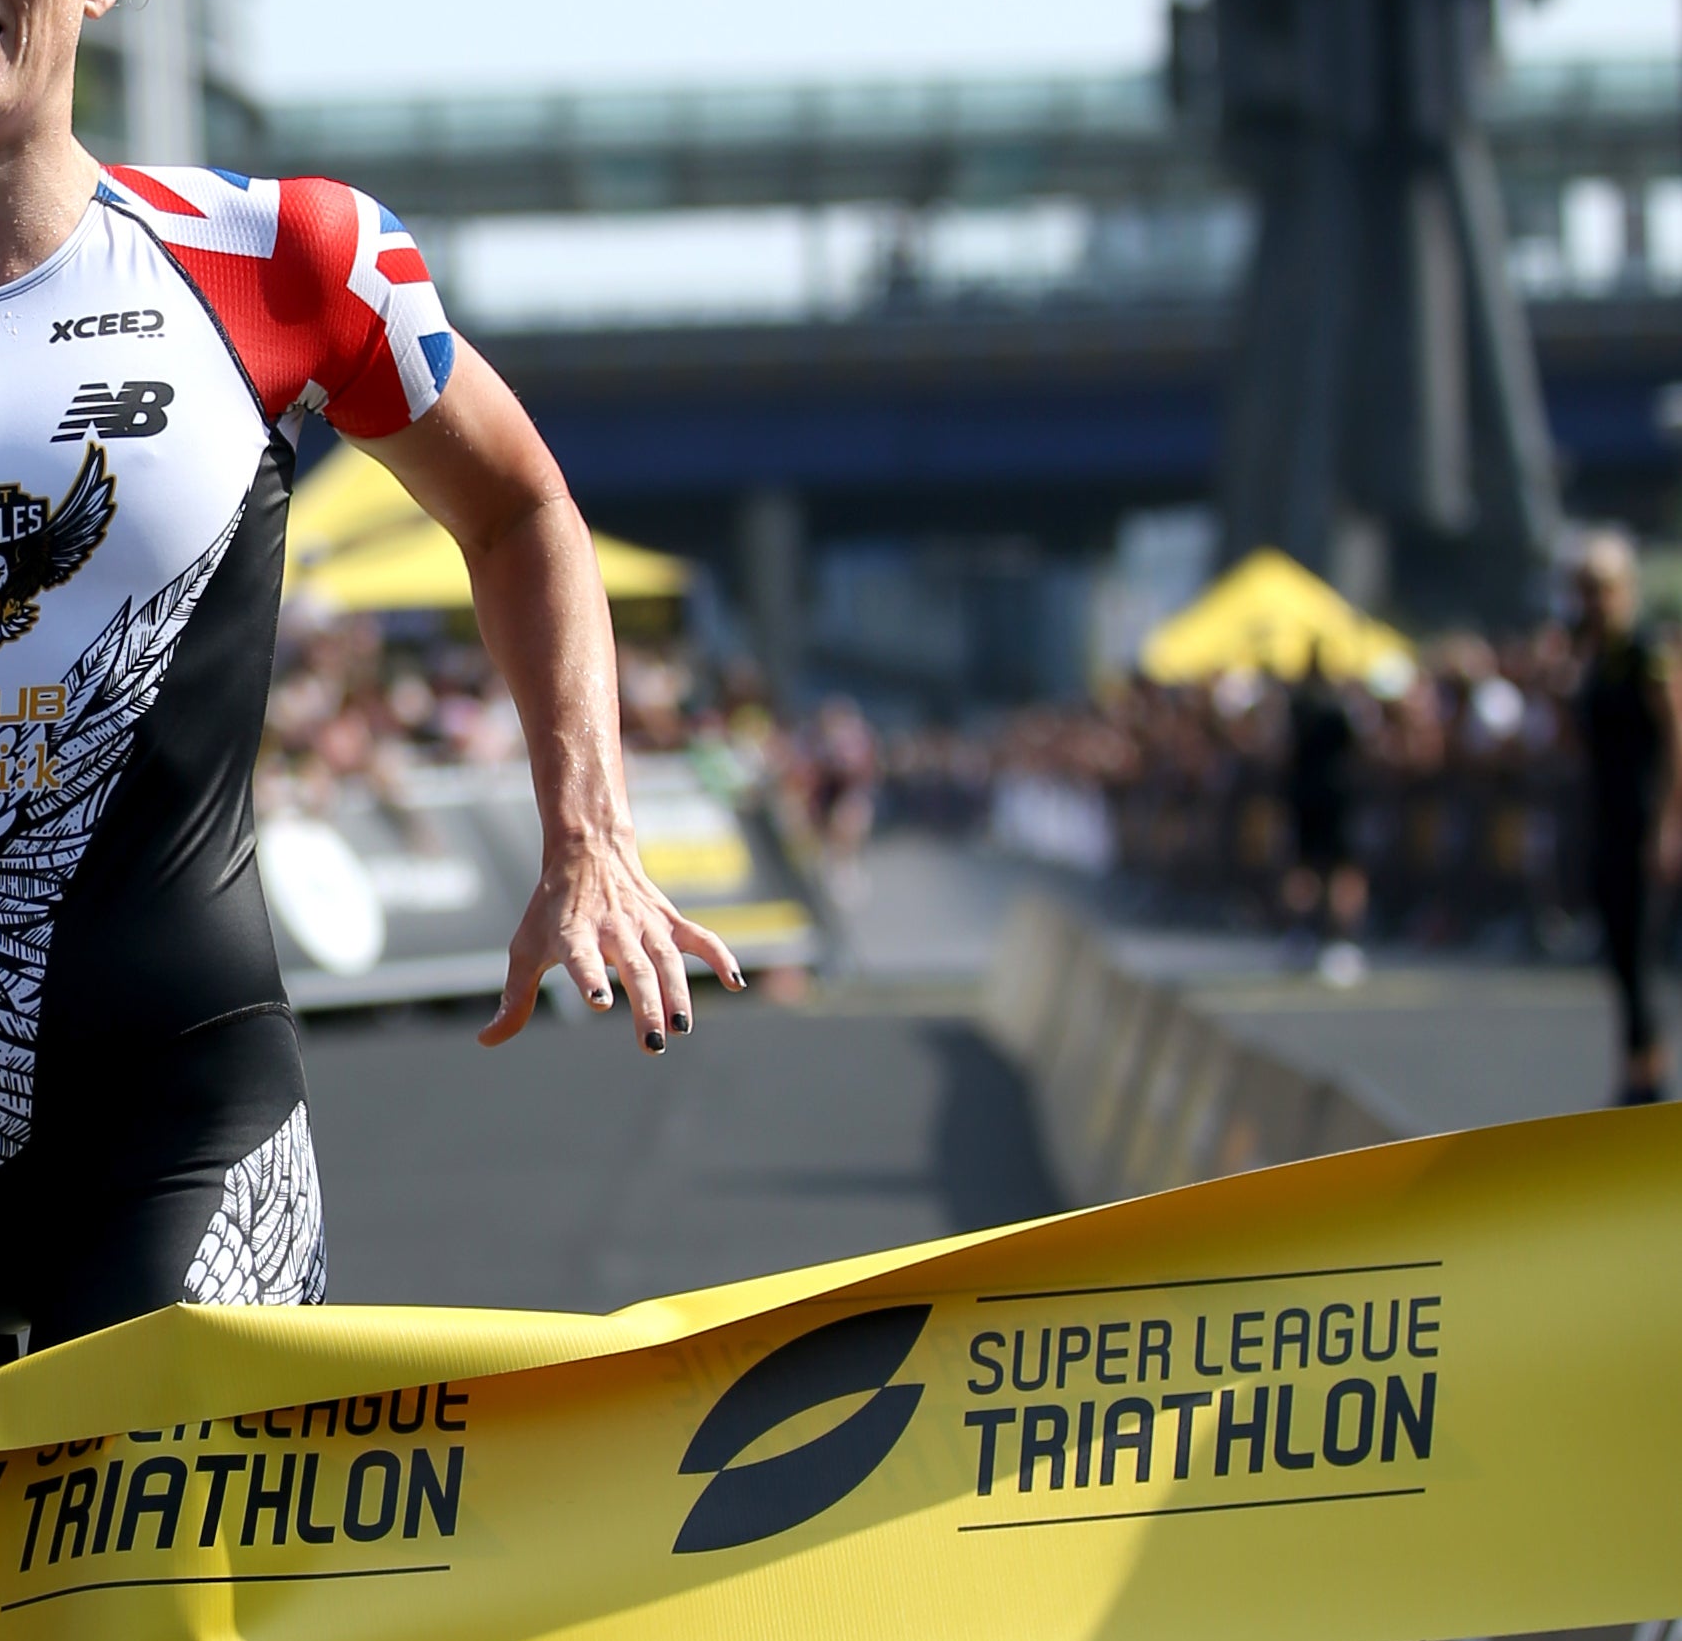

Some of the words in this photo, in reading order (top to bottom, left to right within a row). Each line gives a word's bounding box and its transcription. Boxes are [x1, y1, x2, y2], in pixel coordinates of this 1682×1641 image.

[49, 309, 165, 344] XCEED
[966, 1317, 1173, 1396] SUPER
[1196, 1295, 1442, 1377] LEAGUE
[963, 1371, 1438, 1497] TRIATHLON
[19, 1445, 466, 1574] TRIATHLON
